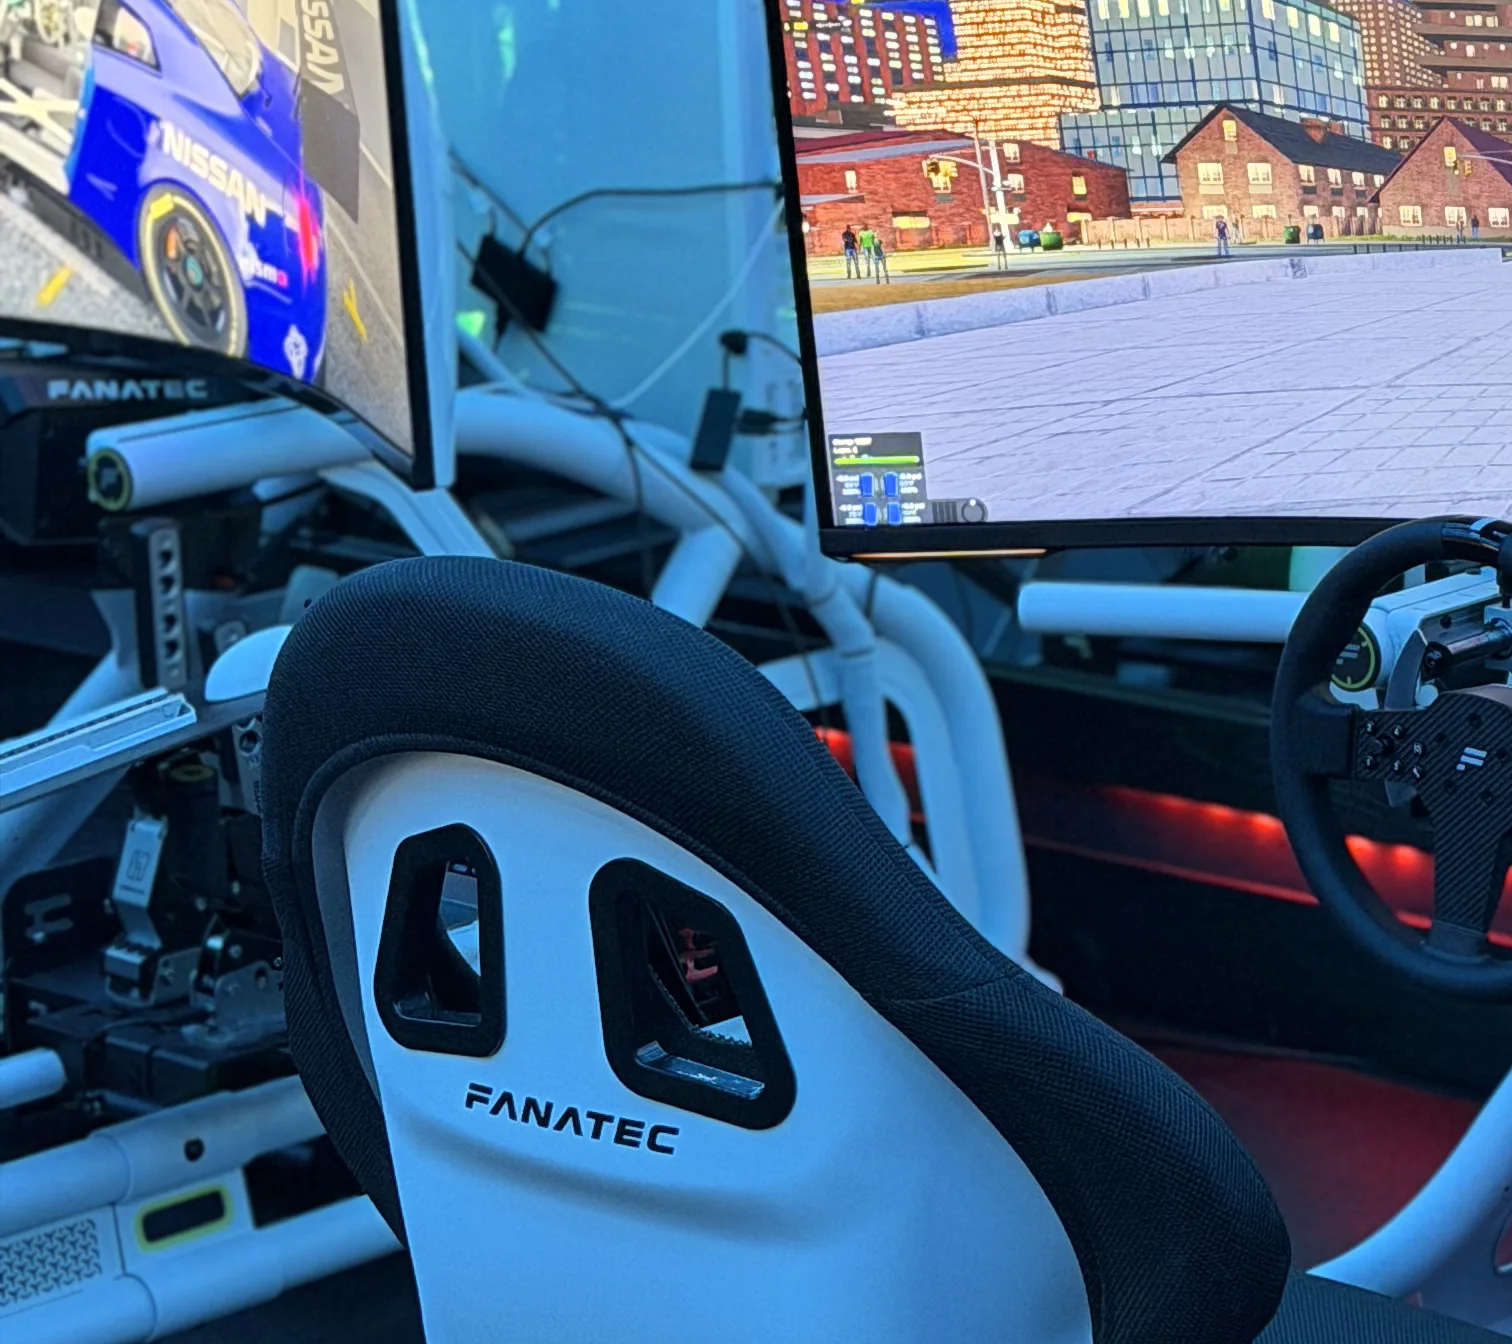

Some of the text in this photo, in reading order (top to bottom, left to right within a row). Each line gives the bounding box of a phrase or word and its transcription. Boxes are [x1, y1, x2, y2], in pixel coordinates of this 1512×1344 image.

[160, 120, 267, 229] NISSAN
[47, 379, 208, 401] FANATEC
[465, 1082, 680, 1155] FANATEC
